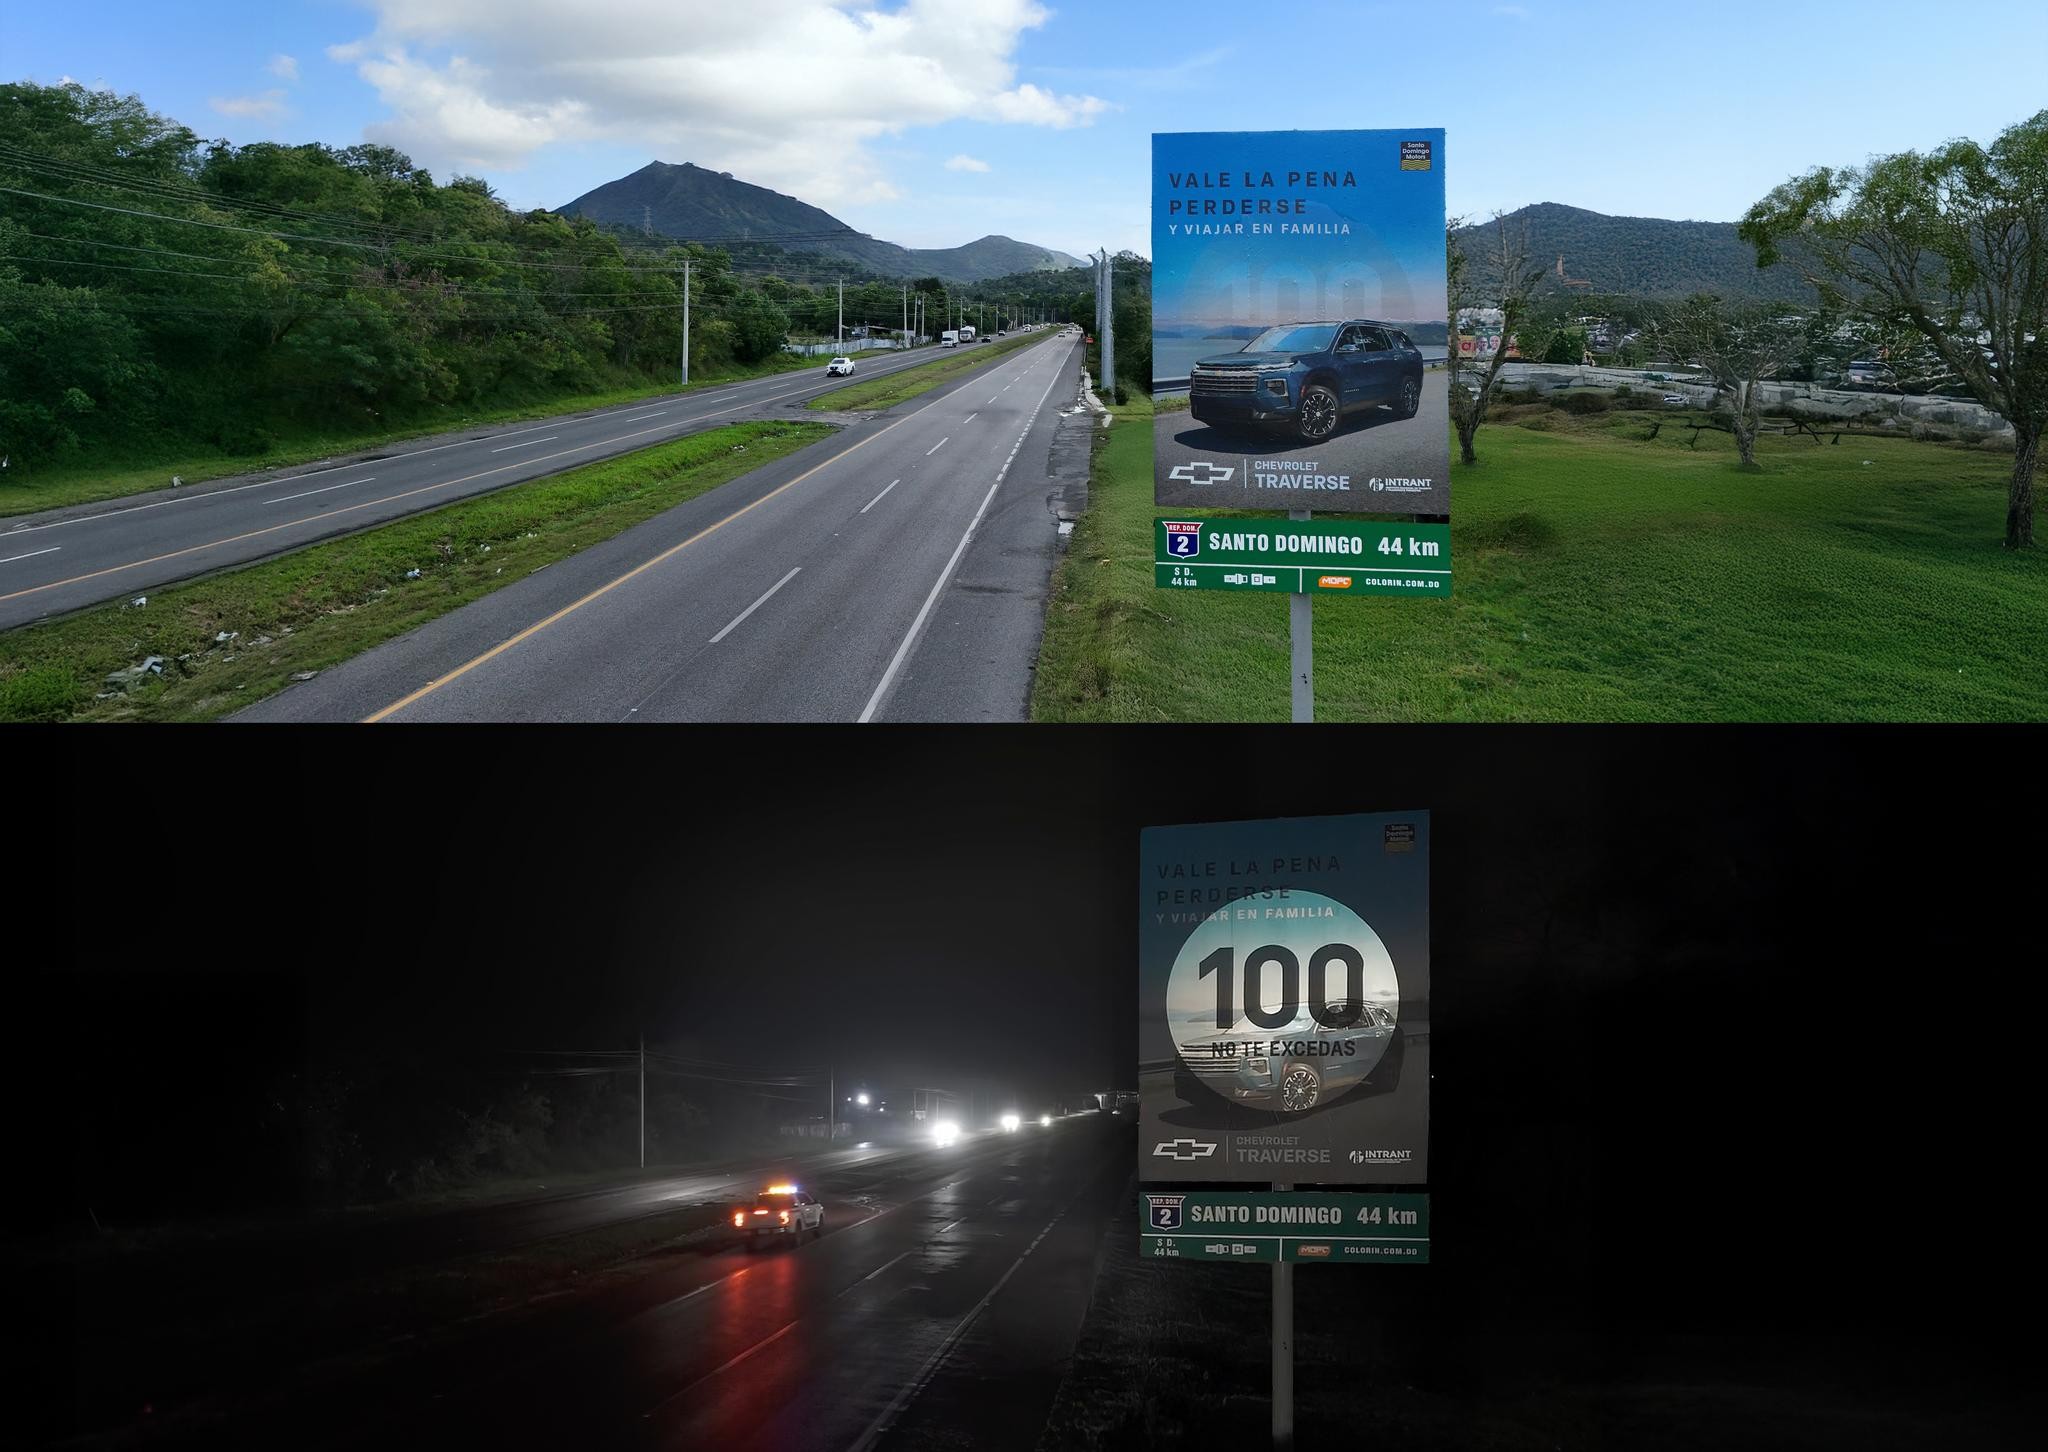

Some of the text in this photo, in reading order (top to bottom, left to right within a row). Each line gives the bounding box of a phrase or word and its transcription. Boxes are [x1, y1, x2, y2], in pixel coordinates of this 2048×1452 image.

[1169, 170, 1357, 188] VALE LA PENA
[1169, 199, 1307, 215] PERDERSE
[1169, 223, 1350, 235] Y VIAJAR EN FAMILIA
[1254, 460, 1319, 471] CHEVROLET
[1254, 474, 1350, 491] TRAVERSE
[1385, 477, 1432, 487] INTRANT
[1177, 535, 1189, 553] 2
[1209, 532, 1439, 556] SANTO DOMINGO 44 km
[1174, 567, 1194, 577] S D.
[1171, 577, 1197, 587] 44 km
[1321, 577, 1349, 585] MOPC
[1365, 577, 1440, 588] COLORIN.COM.DO
[1157, 855, 1341, 880] VALE LA PENA
[1157, 884, 1291, 906] PERDERSE
[1156, 906, 1335, 924] Y VIAJAR EN FAMILIA
[1199, 943, 1364, 1029] 100
[1211, 1040, 1356, 1059] NO TE EXCEDAS
[1236, 1136, 1299, 1146] CHEVROLET
[1237, 1149, 1331, 1163] TRAVERSE
[1365, 1149, 1412, 1159] INTRANT
[1159, 1208, 1172, 1226] 2
[1191, 1205, 1418, 1226] SANTO DOMINGO 44 km
[1157, 1238, 1163, 1248] S
[1153, 1248, 1180, 1258] 44 km
